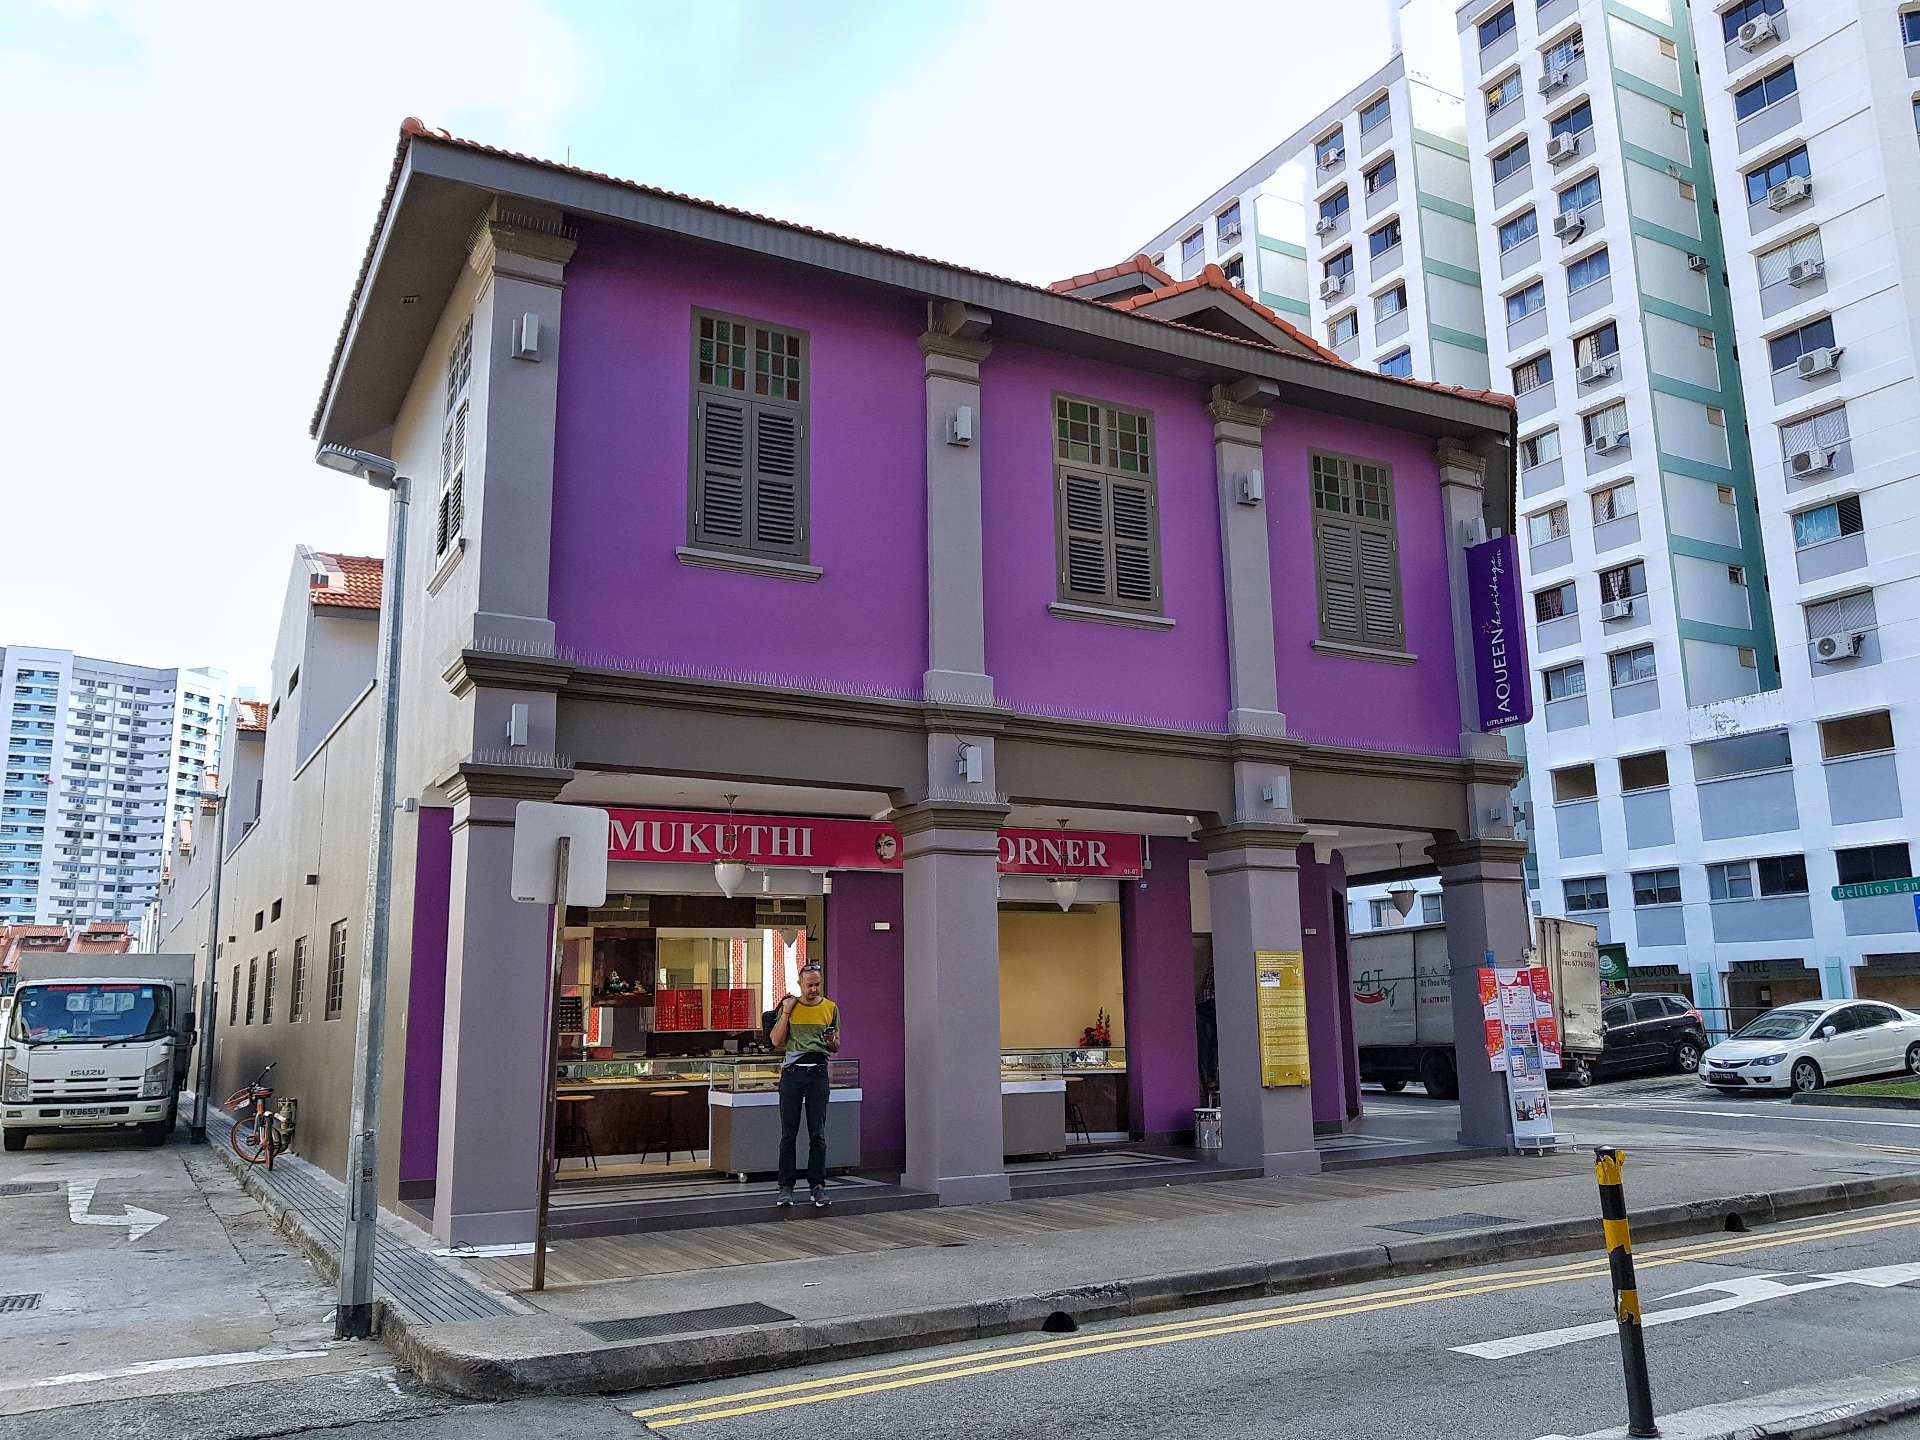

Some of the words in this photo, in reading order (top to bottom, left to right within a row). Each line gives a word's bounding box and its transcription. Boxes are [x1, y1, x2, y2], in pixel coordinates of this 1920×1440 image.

[1490, 556, 1505, 628] heritage
[1491, 629, 1511, 712] AQUEEN
[1486, 718, 1504, 727] LITTLE
[1504, 714, 1519, 724] INDIA
[608, 820, 815, 857] MUKUTHI
[1837, 883, 1889, 899] Belilios
[70, 1069, 105, 1077] ISUZU
